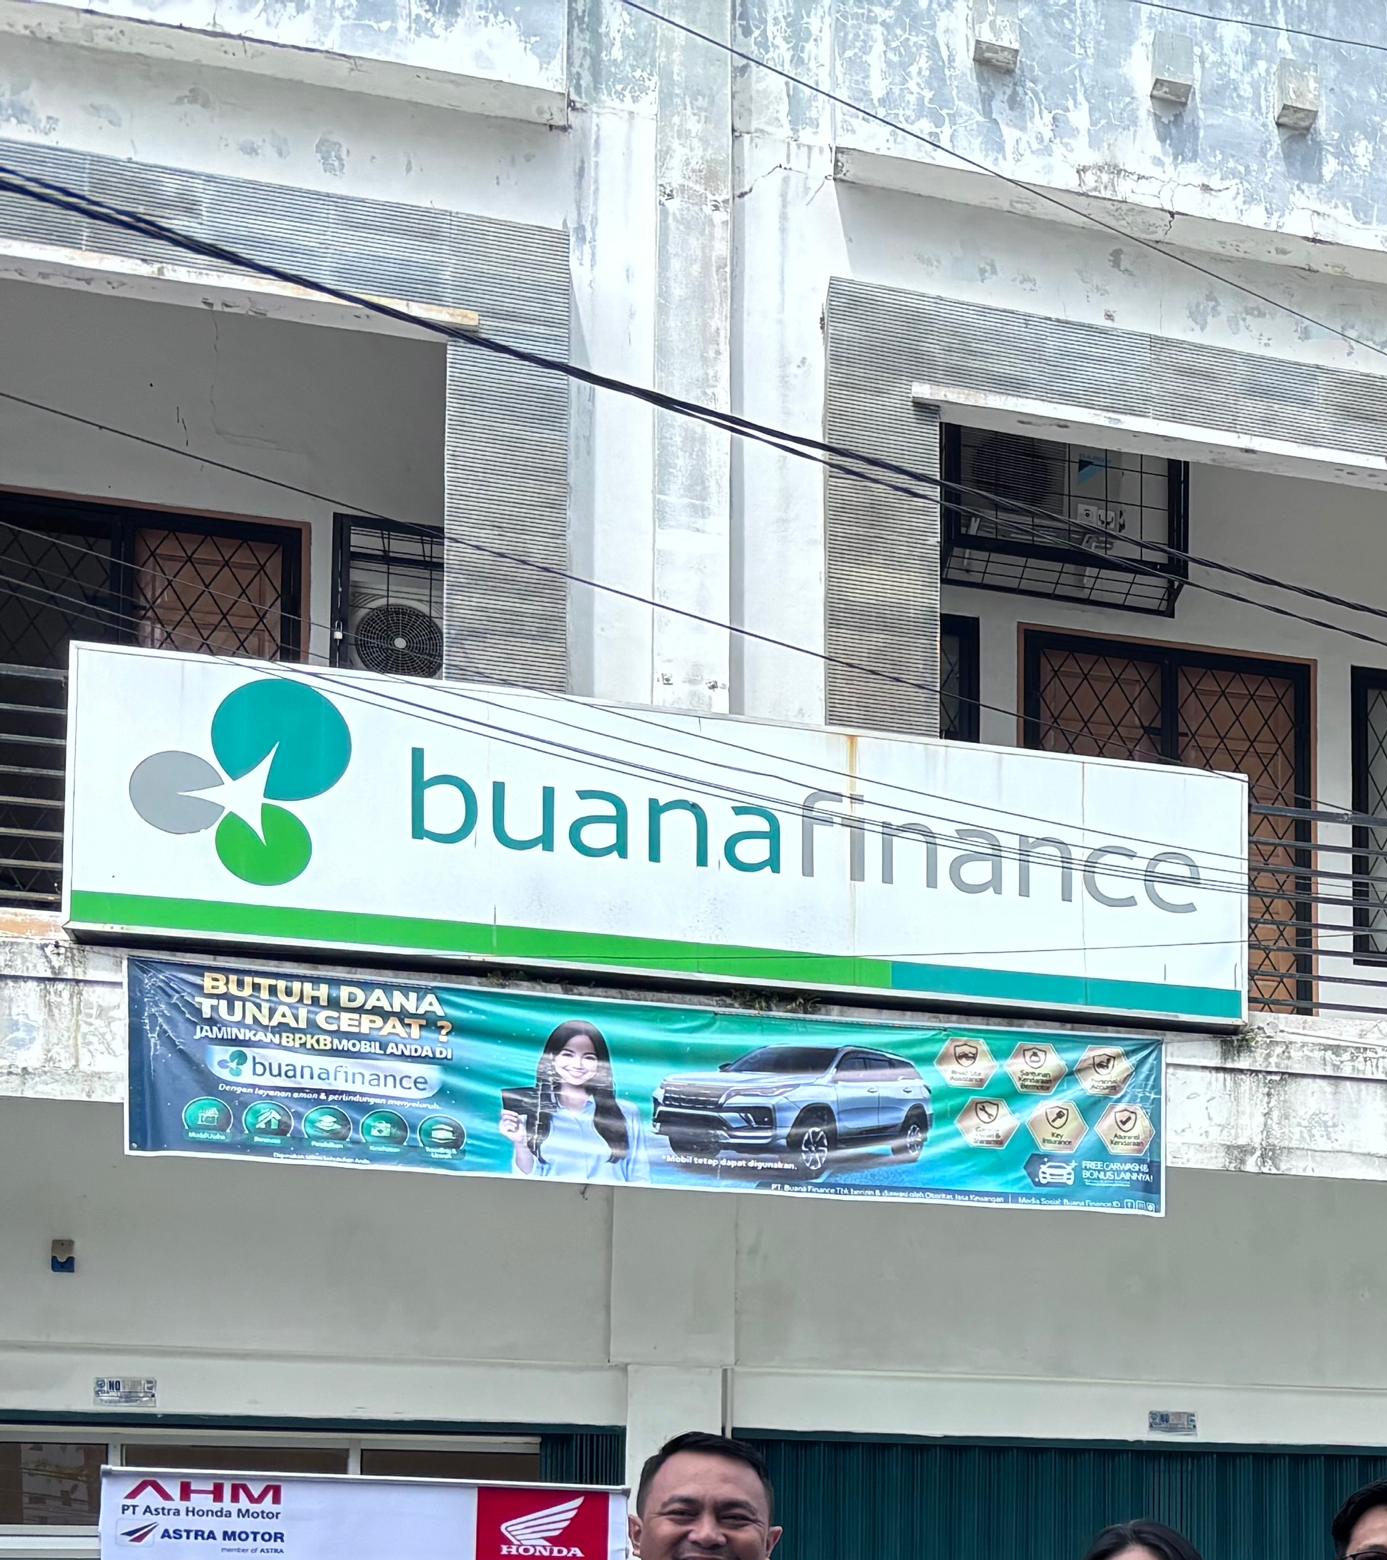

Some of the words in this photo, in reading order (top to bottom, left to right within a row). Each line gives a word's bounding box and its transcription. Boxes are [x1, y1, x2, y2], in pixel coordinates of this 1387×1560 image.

[410, 746, 1202, 915] buanafinance
[203, 972, 330, 1007] BUTUH
[340, 985, 446, 1016] DANA
[199, 997, 308, 1029] TUNAI
[316, 1010, 426, 1040] CEPAT
[437, 1020, 452, 1043] ?
[194, 1025, 281, 1045] JAMINKAN
[281, 1034, 332, 1051] BPKB
[333, 1038, 384, 1055] MOBIL
[386, 1043, 432, 1058] ANDA
[434, 1047, 453, 1060] DI
[251, 1055, 429, 1092] buanafinance
[1082, 1170, 1114, 1180] BONUS
[123, 1479, 282, 1505] AHM
[121, 1504, 139, 1516] PT
[142, 1505, 181, 1517] Astra
[185, 1507, 232, 1519] Honda
[237, 1508, 281, 1520] Motor
[160, 1528, 217, 1541] ASTRA
[222, 1530, 285, 1543] MOTOR
[500, 1544, 585, 1558] HONDA
